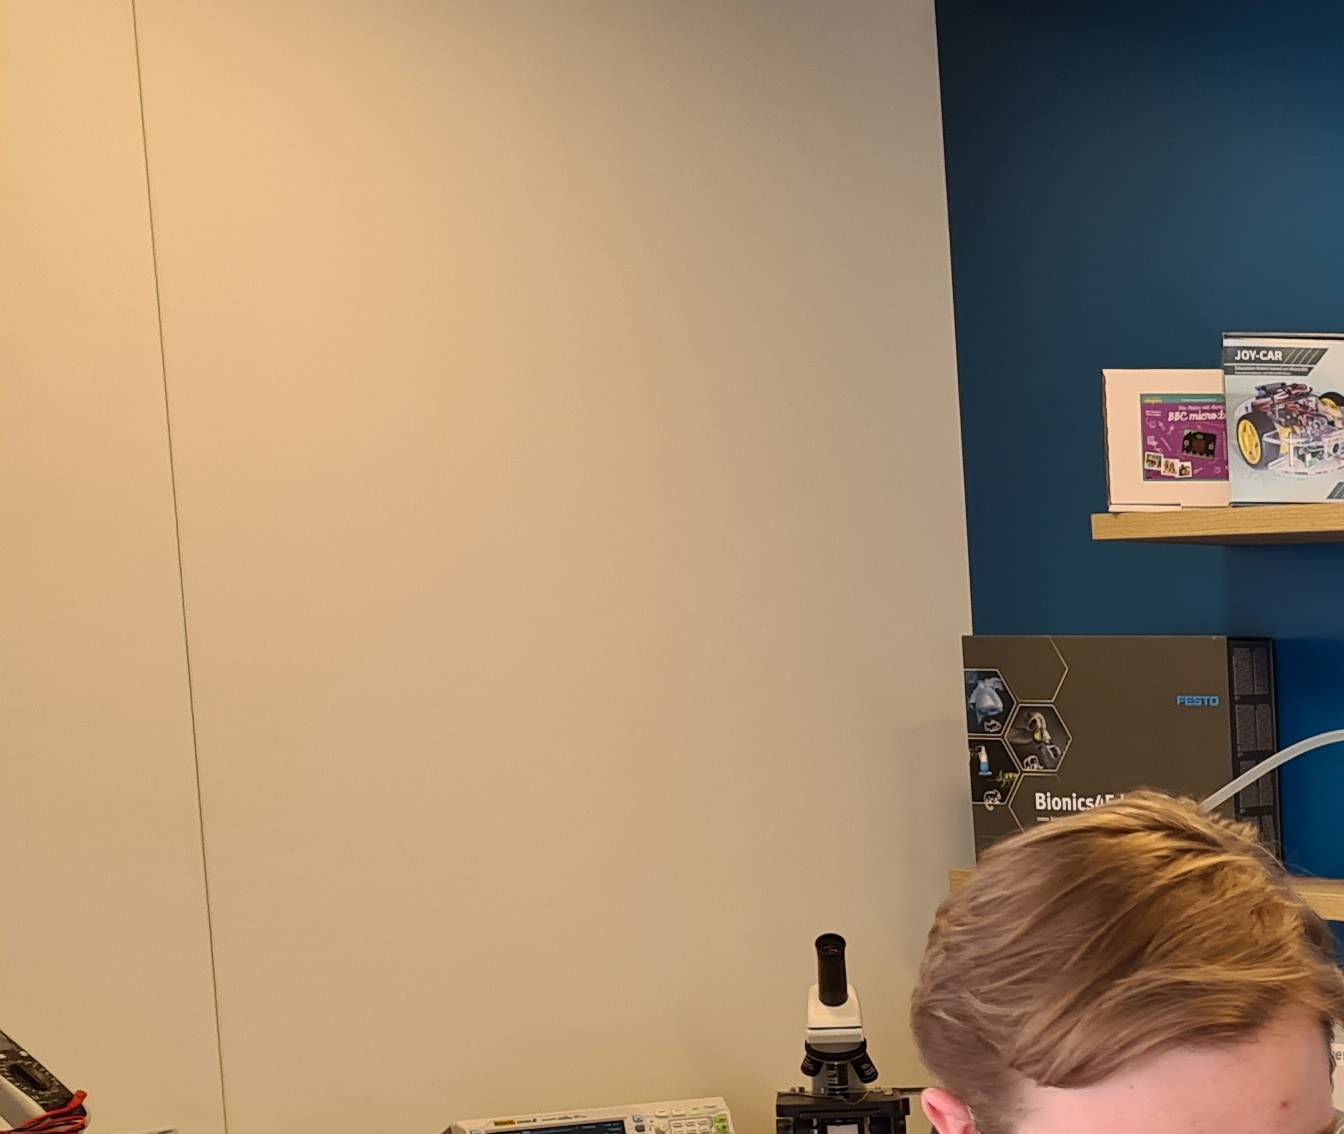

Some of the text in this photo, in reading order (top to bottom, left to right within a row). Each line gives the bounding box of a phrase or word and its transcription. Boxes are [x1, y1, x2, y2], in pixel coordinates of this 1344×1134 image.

[1235, 350, 1282, 361] JOY-CAR
[1168, 411, 1188, 421] BBC
[1177, 695, 1219, 706] FESTO
